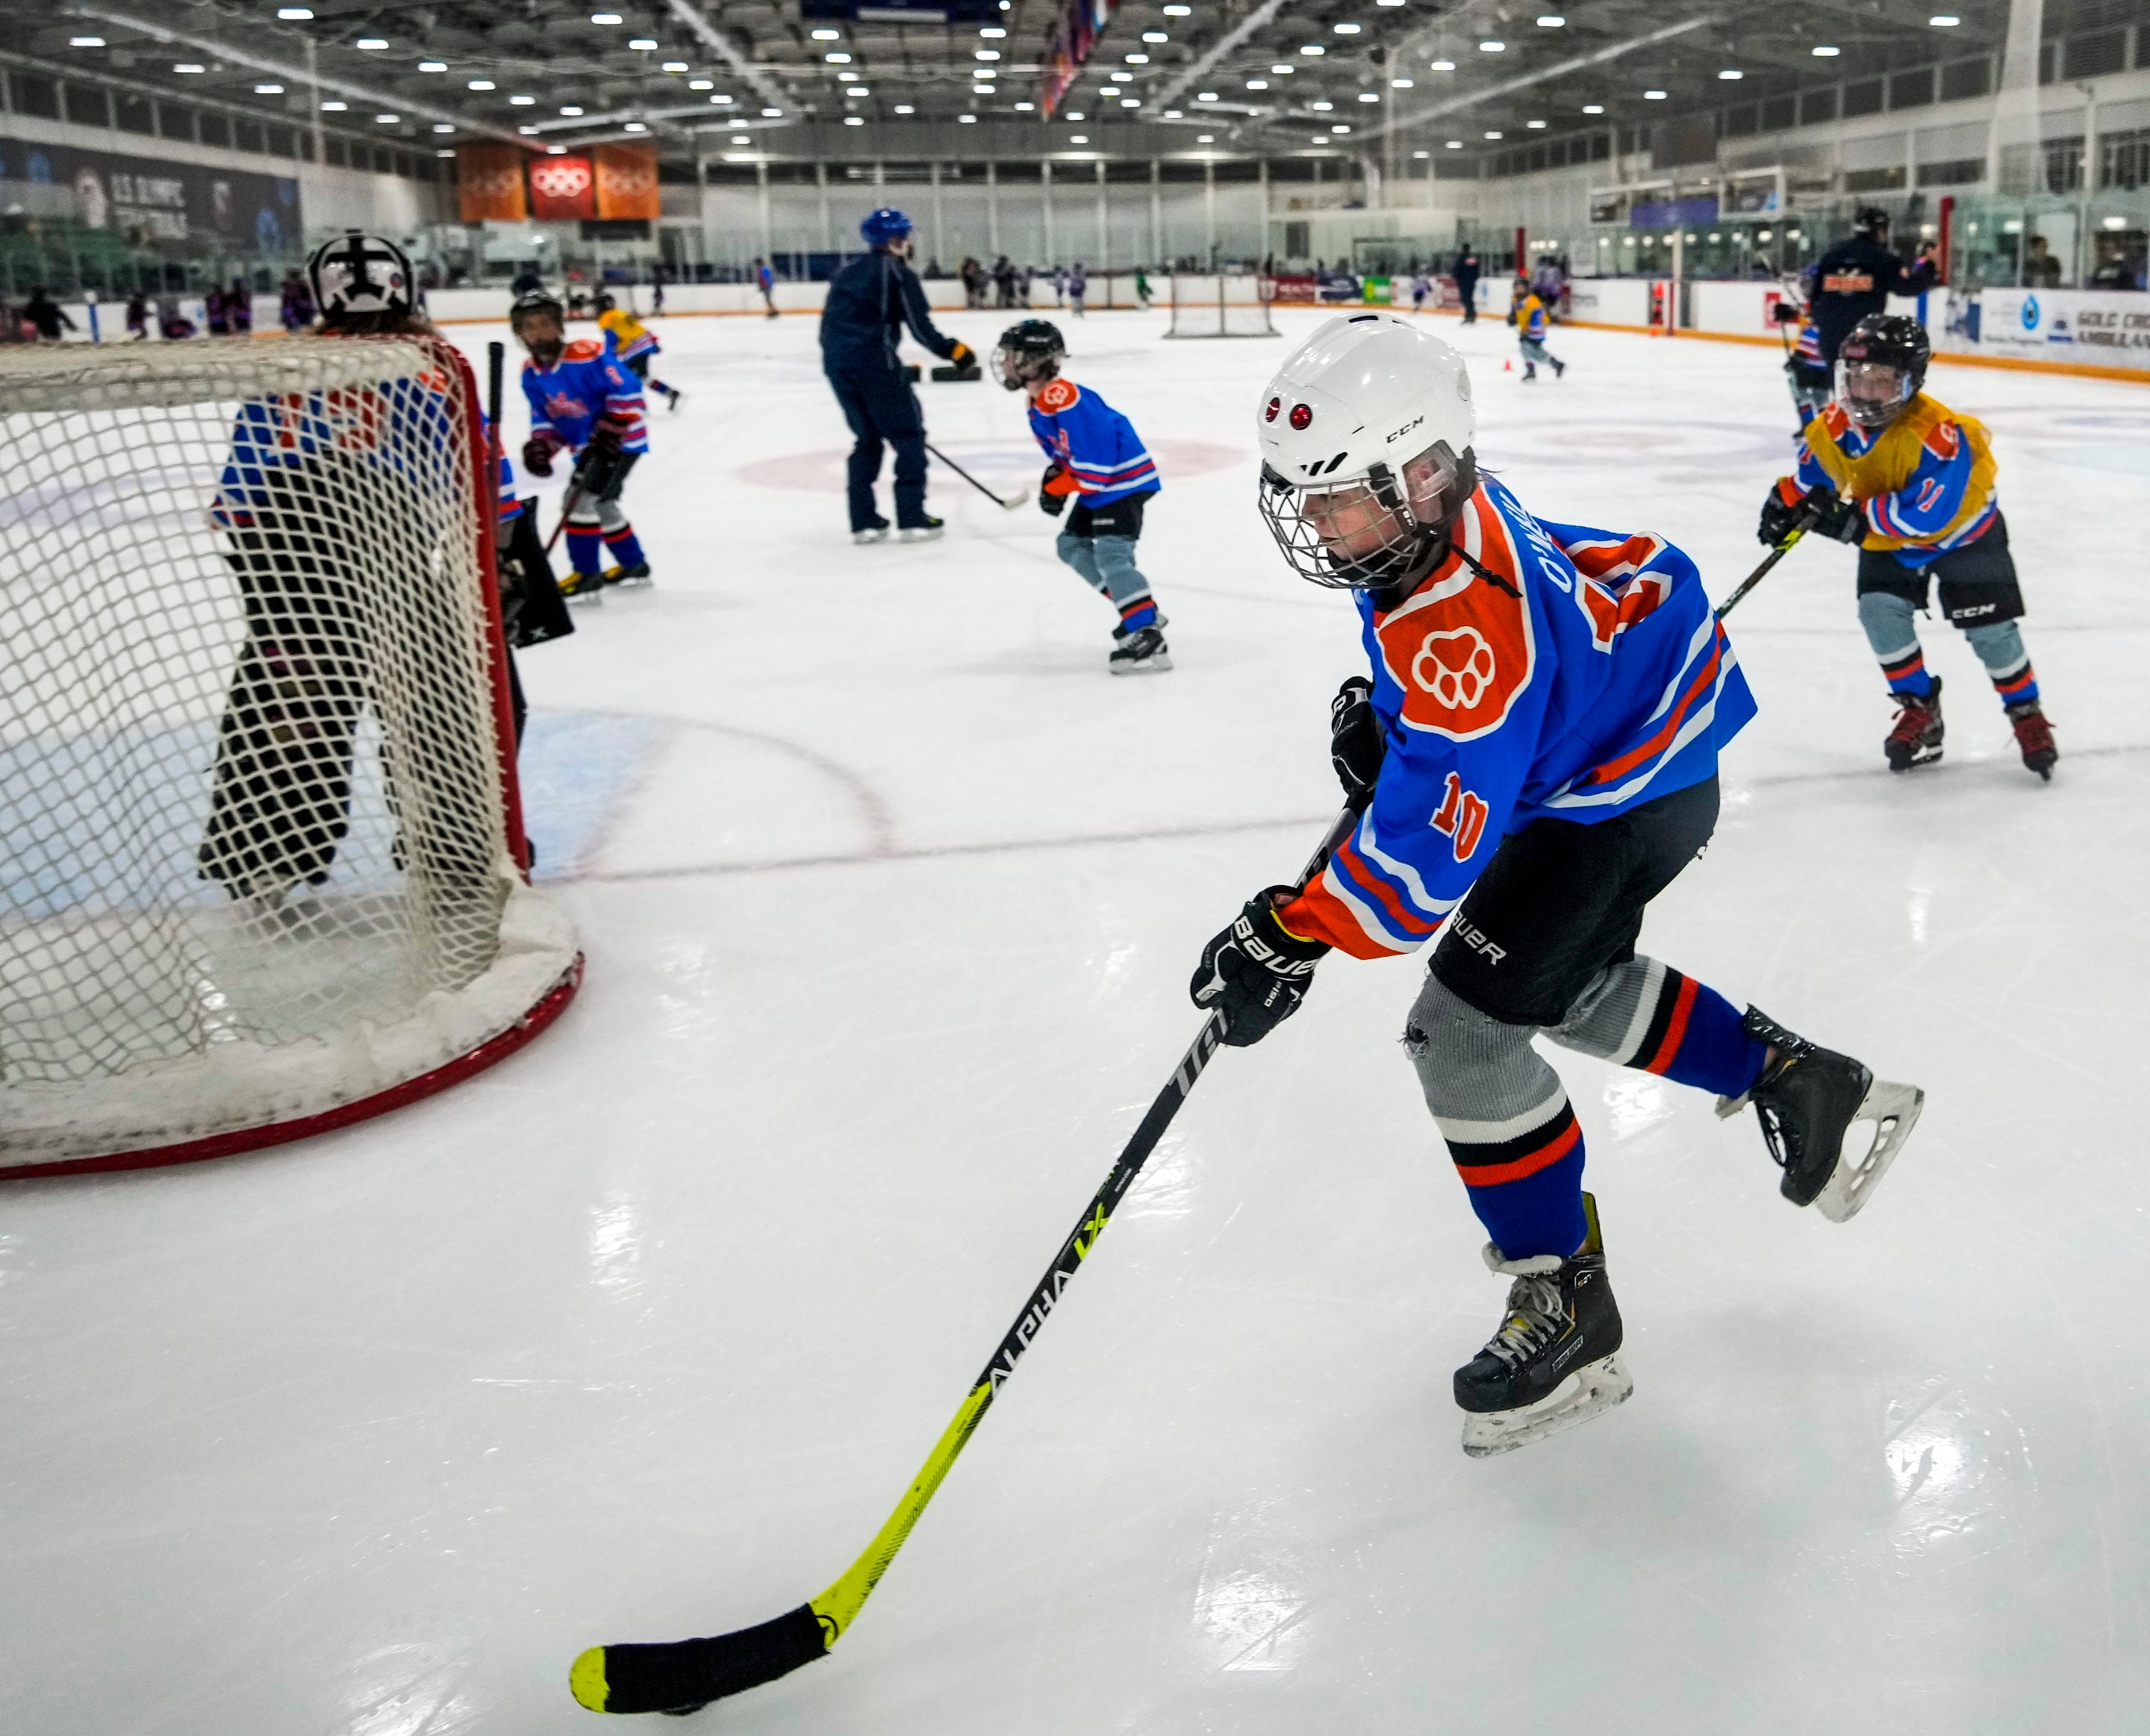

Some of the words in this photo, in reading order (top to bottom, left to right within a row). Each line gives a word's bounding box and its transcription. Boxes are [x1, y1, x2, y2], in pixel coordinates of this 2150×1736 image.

[1385, 415, 1424, 443] CCM
[1916, 477, 1945, 513] 11
[1951, 603, 1997, 619] CCM
[1430, 771, 1489, 863] 10
[1234, 915, 1320, 975] BAUE
[1452, 910, 1507, 966] AUER
[1074, 1202, 1110, 1261] LX
[990, 1269, 1075, 1399] ALPHA
